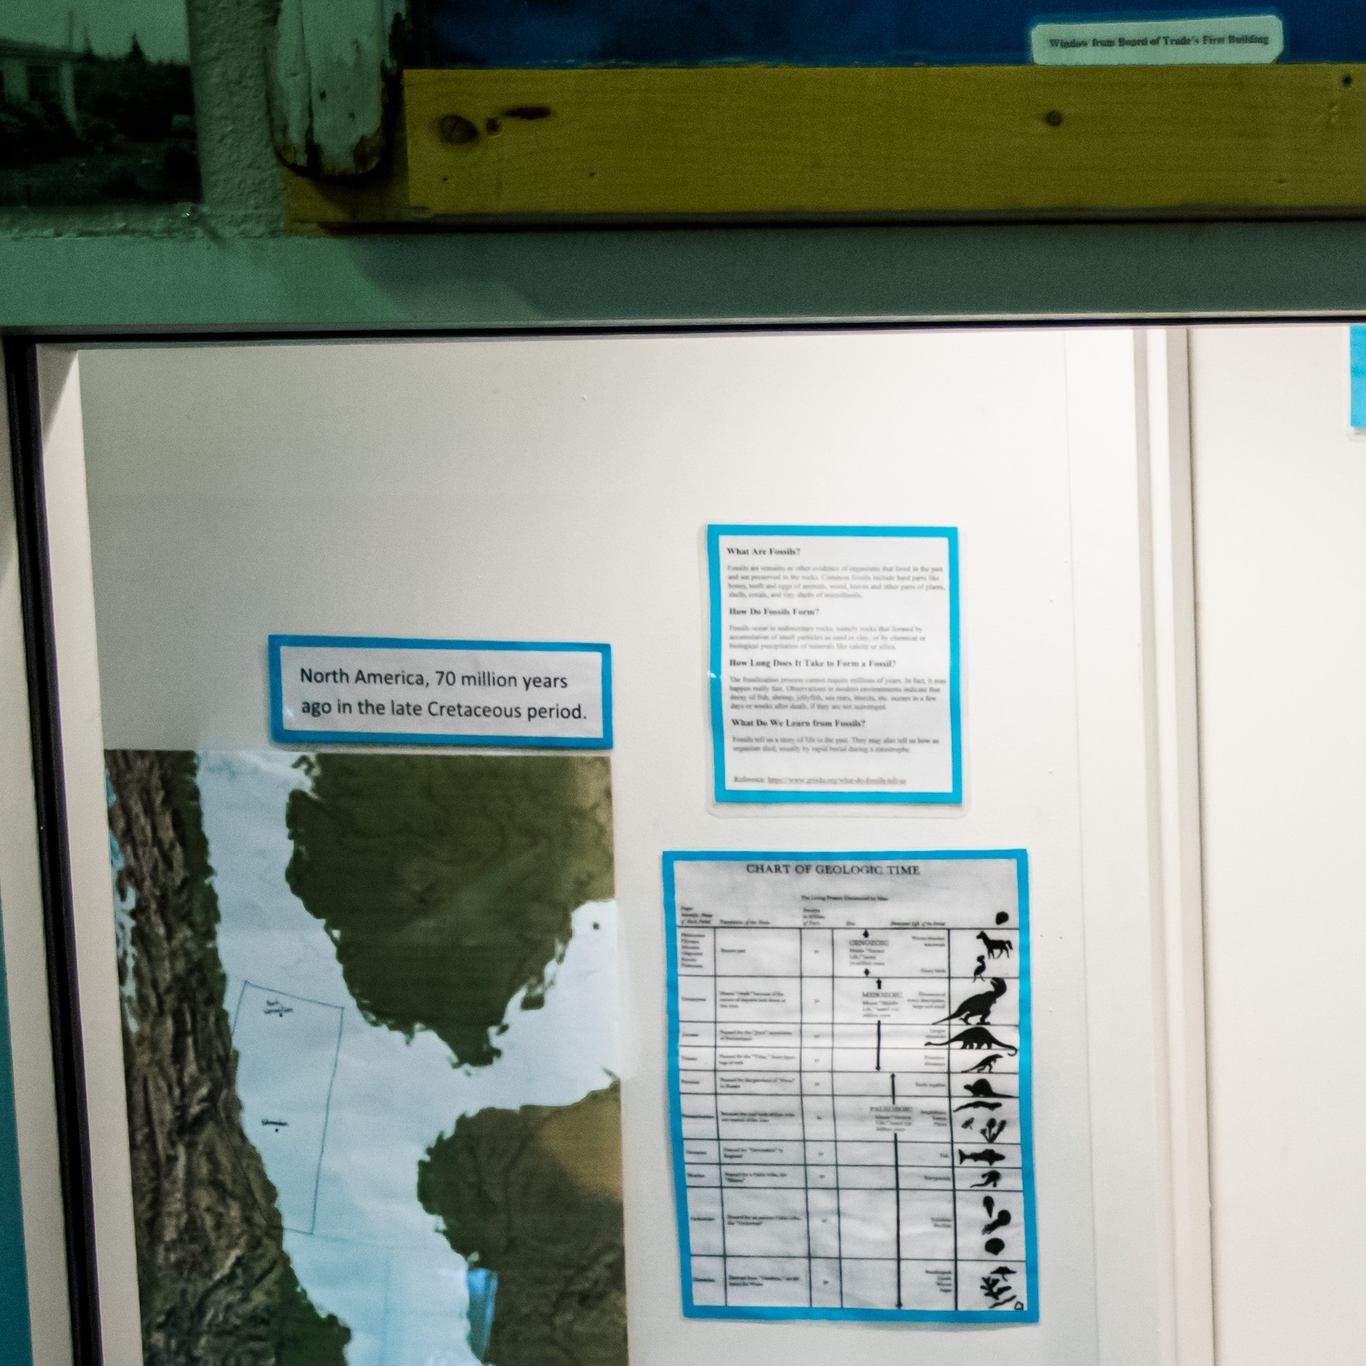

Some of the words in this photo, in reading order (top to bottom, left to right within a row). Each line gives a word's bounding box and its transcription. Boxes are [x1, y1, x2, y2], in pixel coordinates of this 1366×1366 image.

[300, 667, 349, 683] North
[354, 669, 429, 688] America,
[435, 670, 456, 686] 70
[461, 671, 517, 687] million
[522, 676, 568, 690] years
[301, 700, 331, 717] ago
[337, 698, 352, 713] in
[357, 698, 385, 715] the
[390, 699, 422, 716] late
[427, 700, 521, 718] Cretaceous
[527, 703, 586, 722] period.
[745, 863, 790, 873] CHART
[794, 863, 812, 874] OF
[814, 864, 883, 874] GEOLOGIC
[886, 865, 920, 875] TIME
